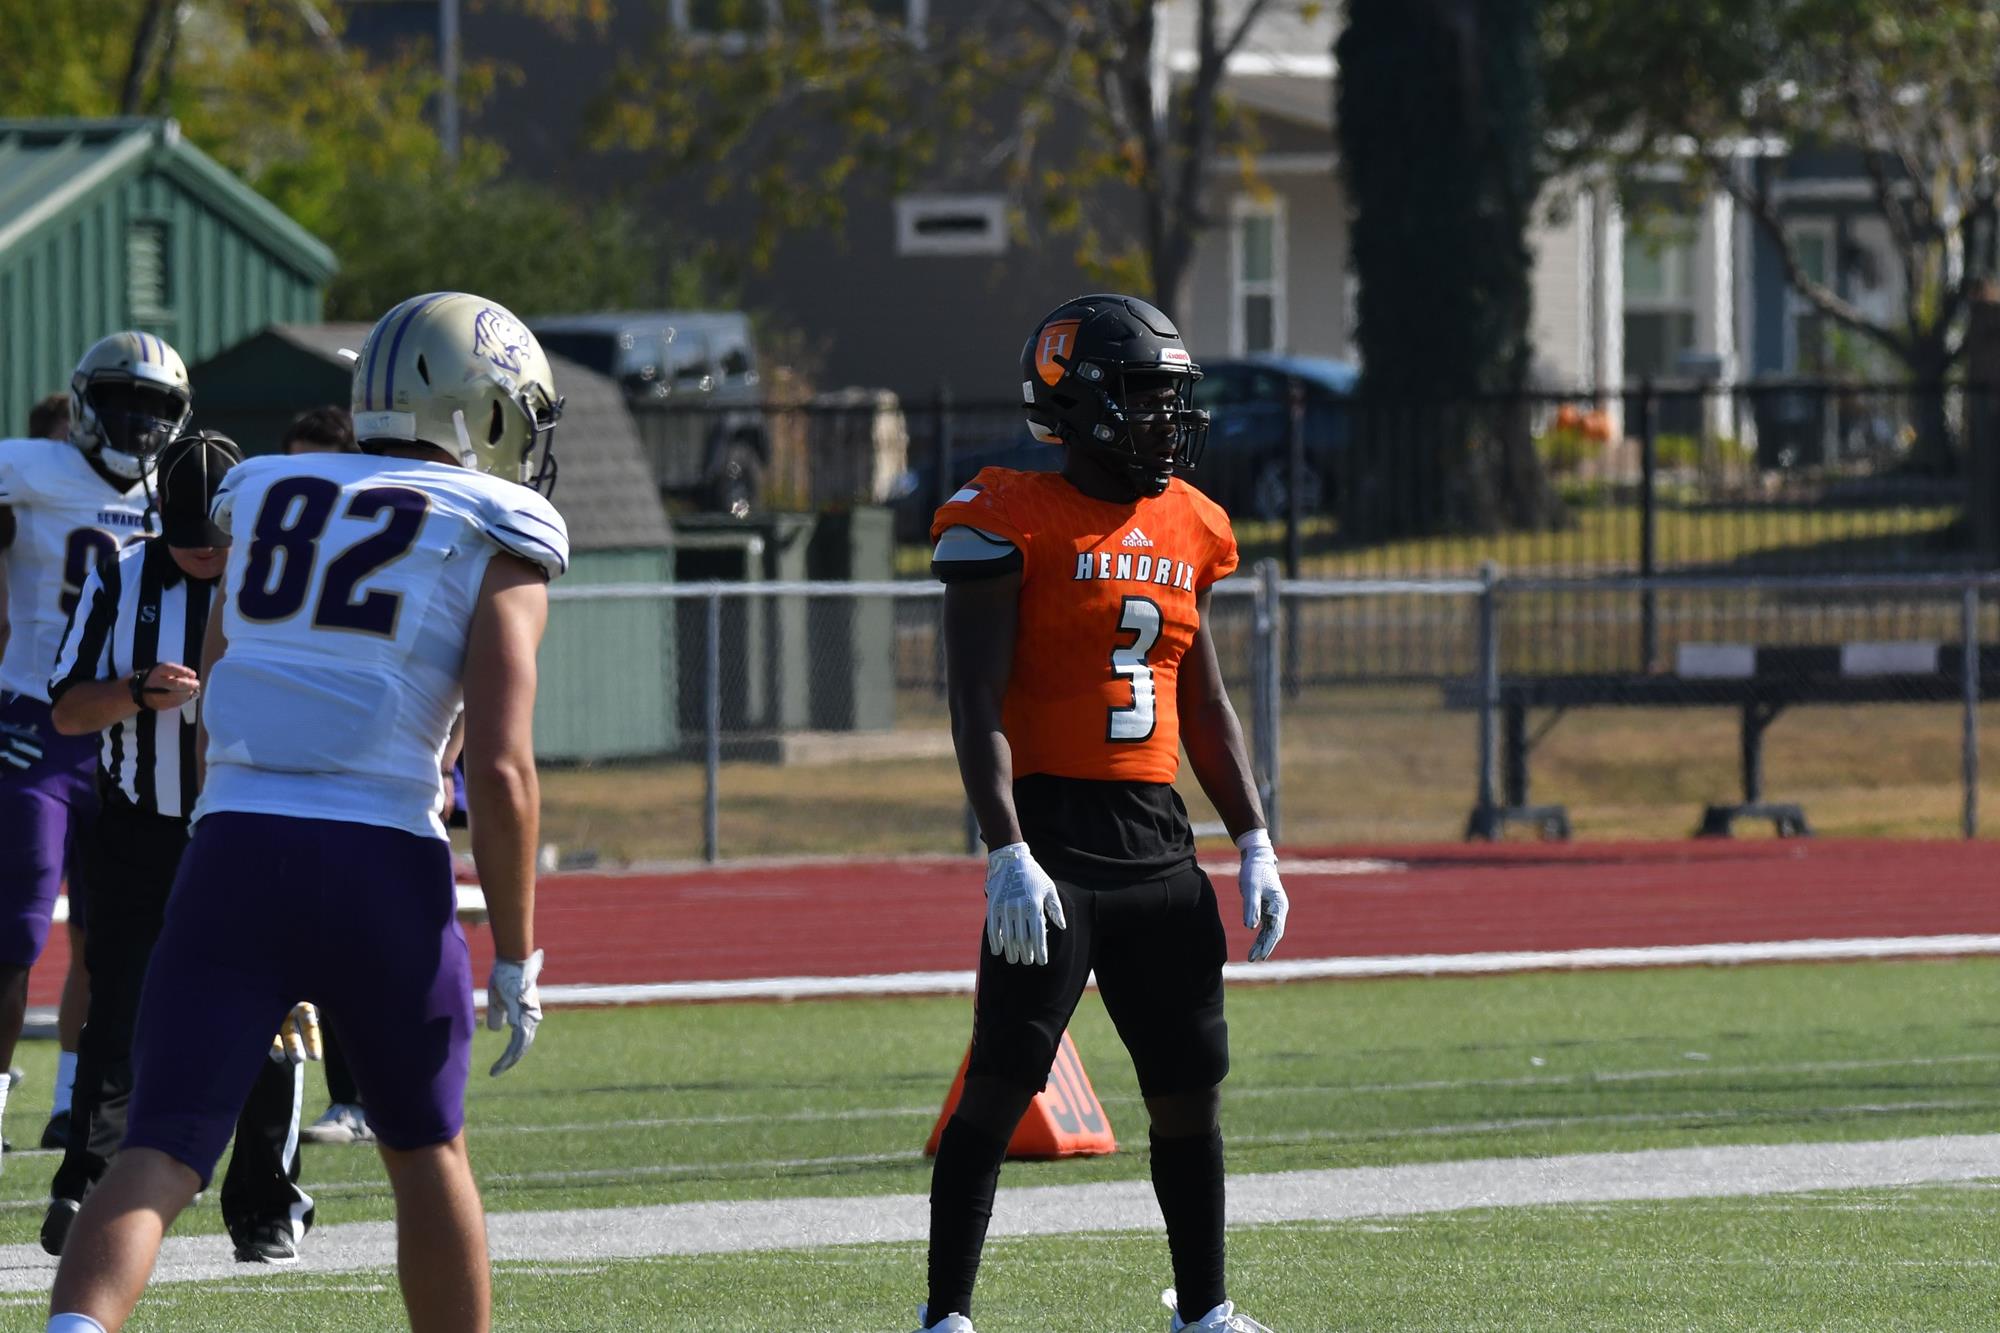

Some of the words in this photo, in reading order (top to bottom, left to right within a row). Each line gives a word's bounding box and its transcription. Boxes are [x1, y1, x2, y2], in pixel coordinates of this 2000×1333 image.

[1041, 334, 1068, 365] H
[236, 474, 433, 642] 82
[1121, 539, 1154, 547] adidas
[1072, 551, 1194, 592] HENDRIX
[1105, 595, 1164, 743] 3
